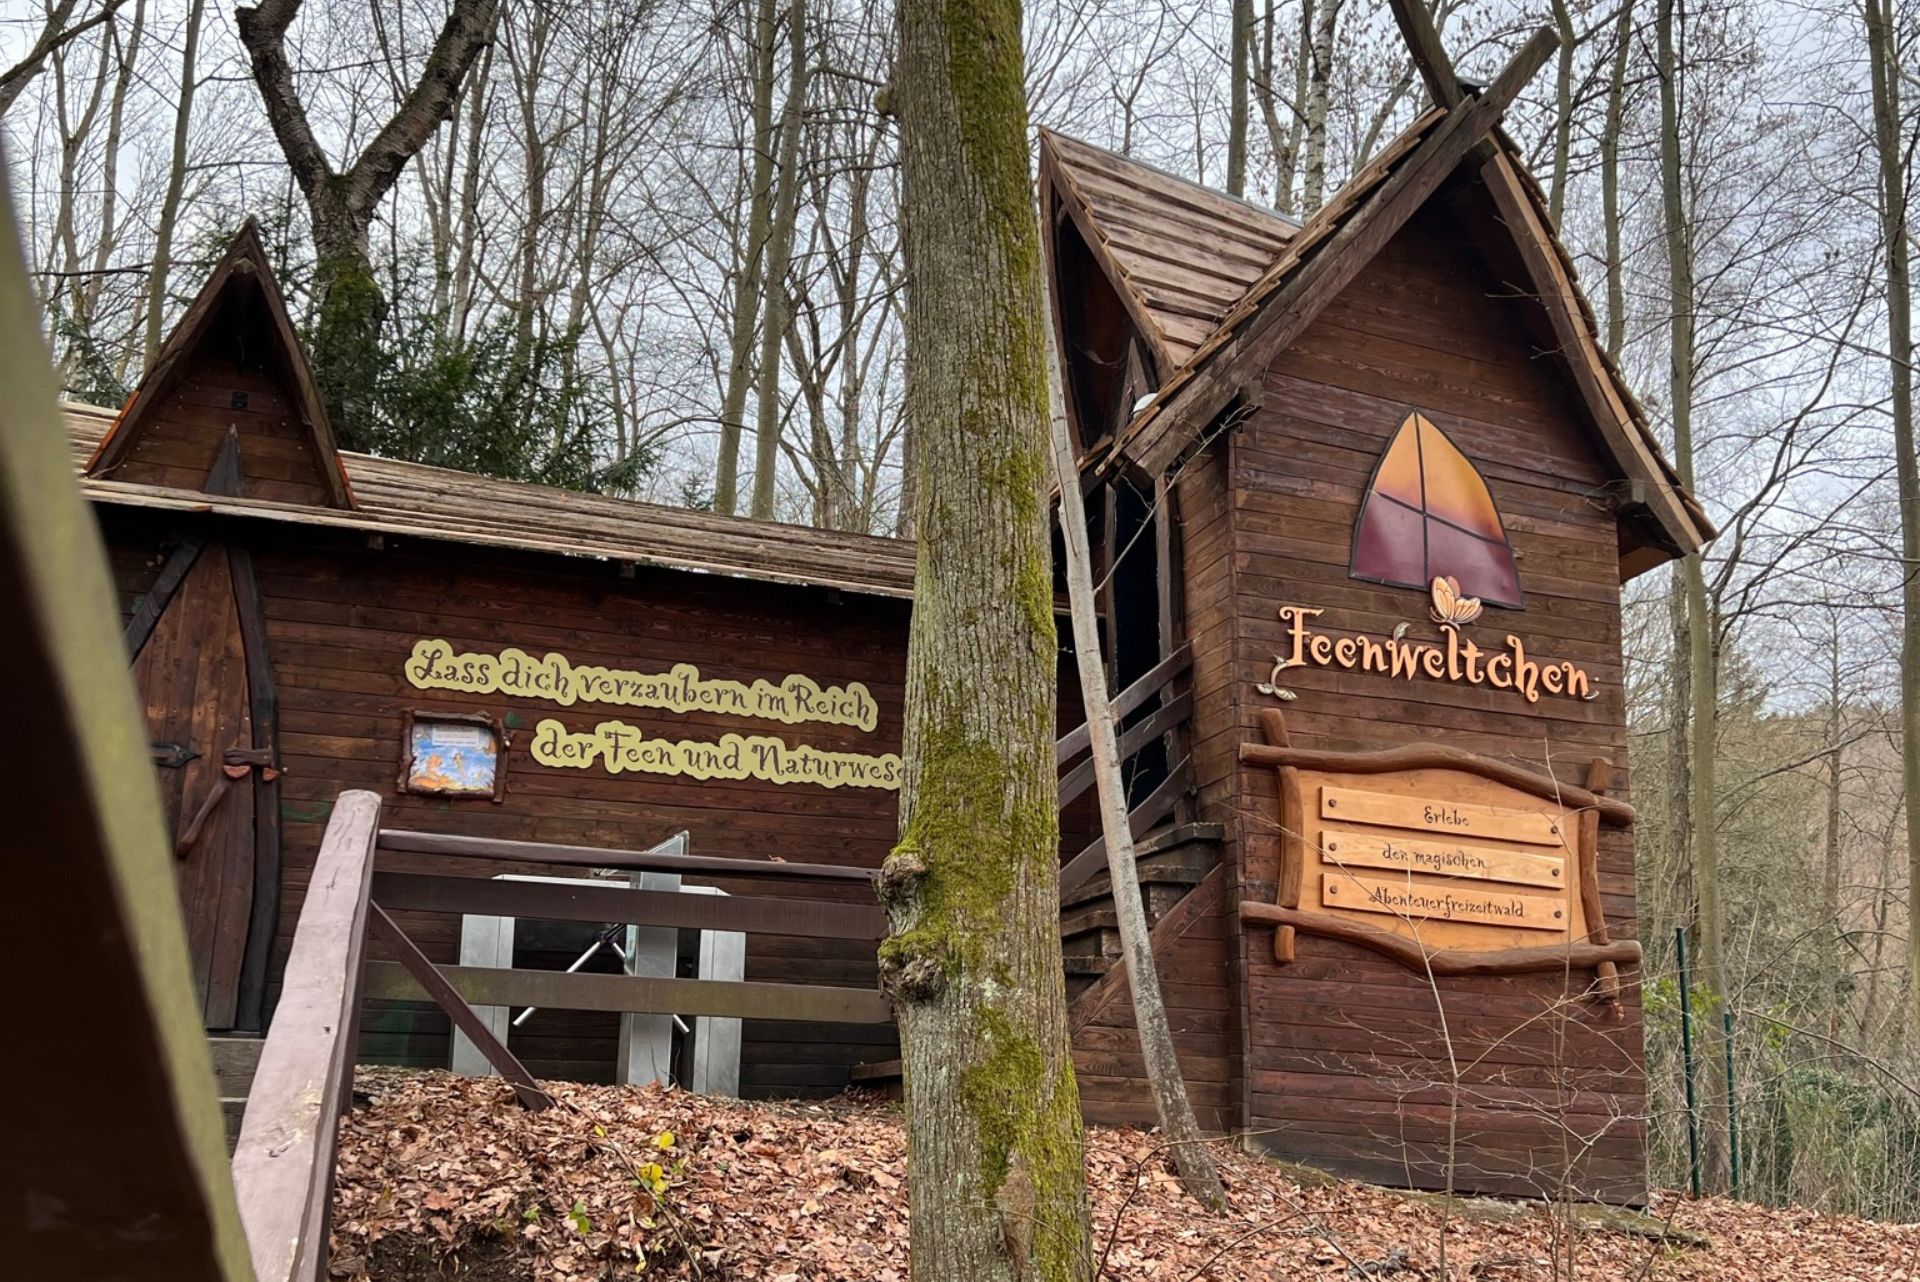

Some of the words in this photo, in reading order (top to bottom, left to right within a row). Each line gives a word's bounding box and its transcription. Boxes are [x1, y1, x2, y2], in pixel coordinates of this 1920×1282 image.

[1279, 606, 1589, 703] Feenweltchen
[413, 648, 490, 686] Lass
[502, 657, 569, 698] dich
[580, 671, 747, 710] verzaubern
[758, 687, 789, 717] im
[788, 683, 870, 725] Reich
[540, 727, 593, 760] der
[604, 729, 675, 767] Feen
[683, 741, 743, 772] und
[1423, 805, 1470, 827] Erlebe
[1382, 842, 1409, 862] den
[1413, 850, 1486, 871] magischen
[1368, 886, 1525, 918] Abenteuerfreizeitwald
